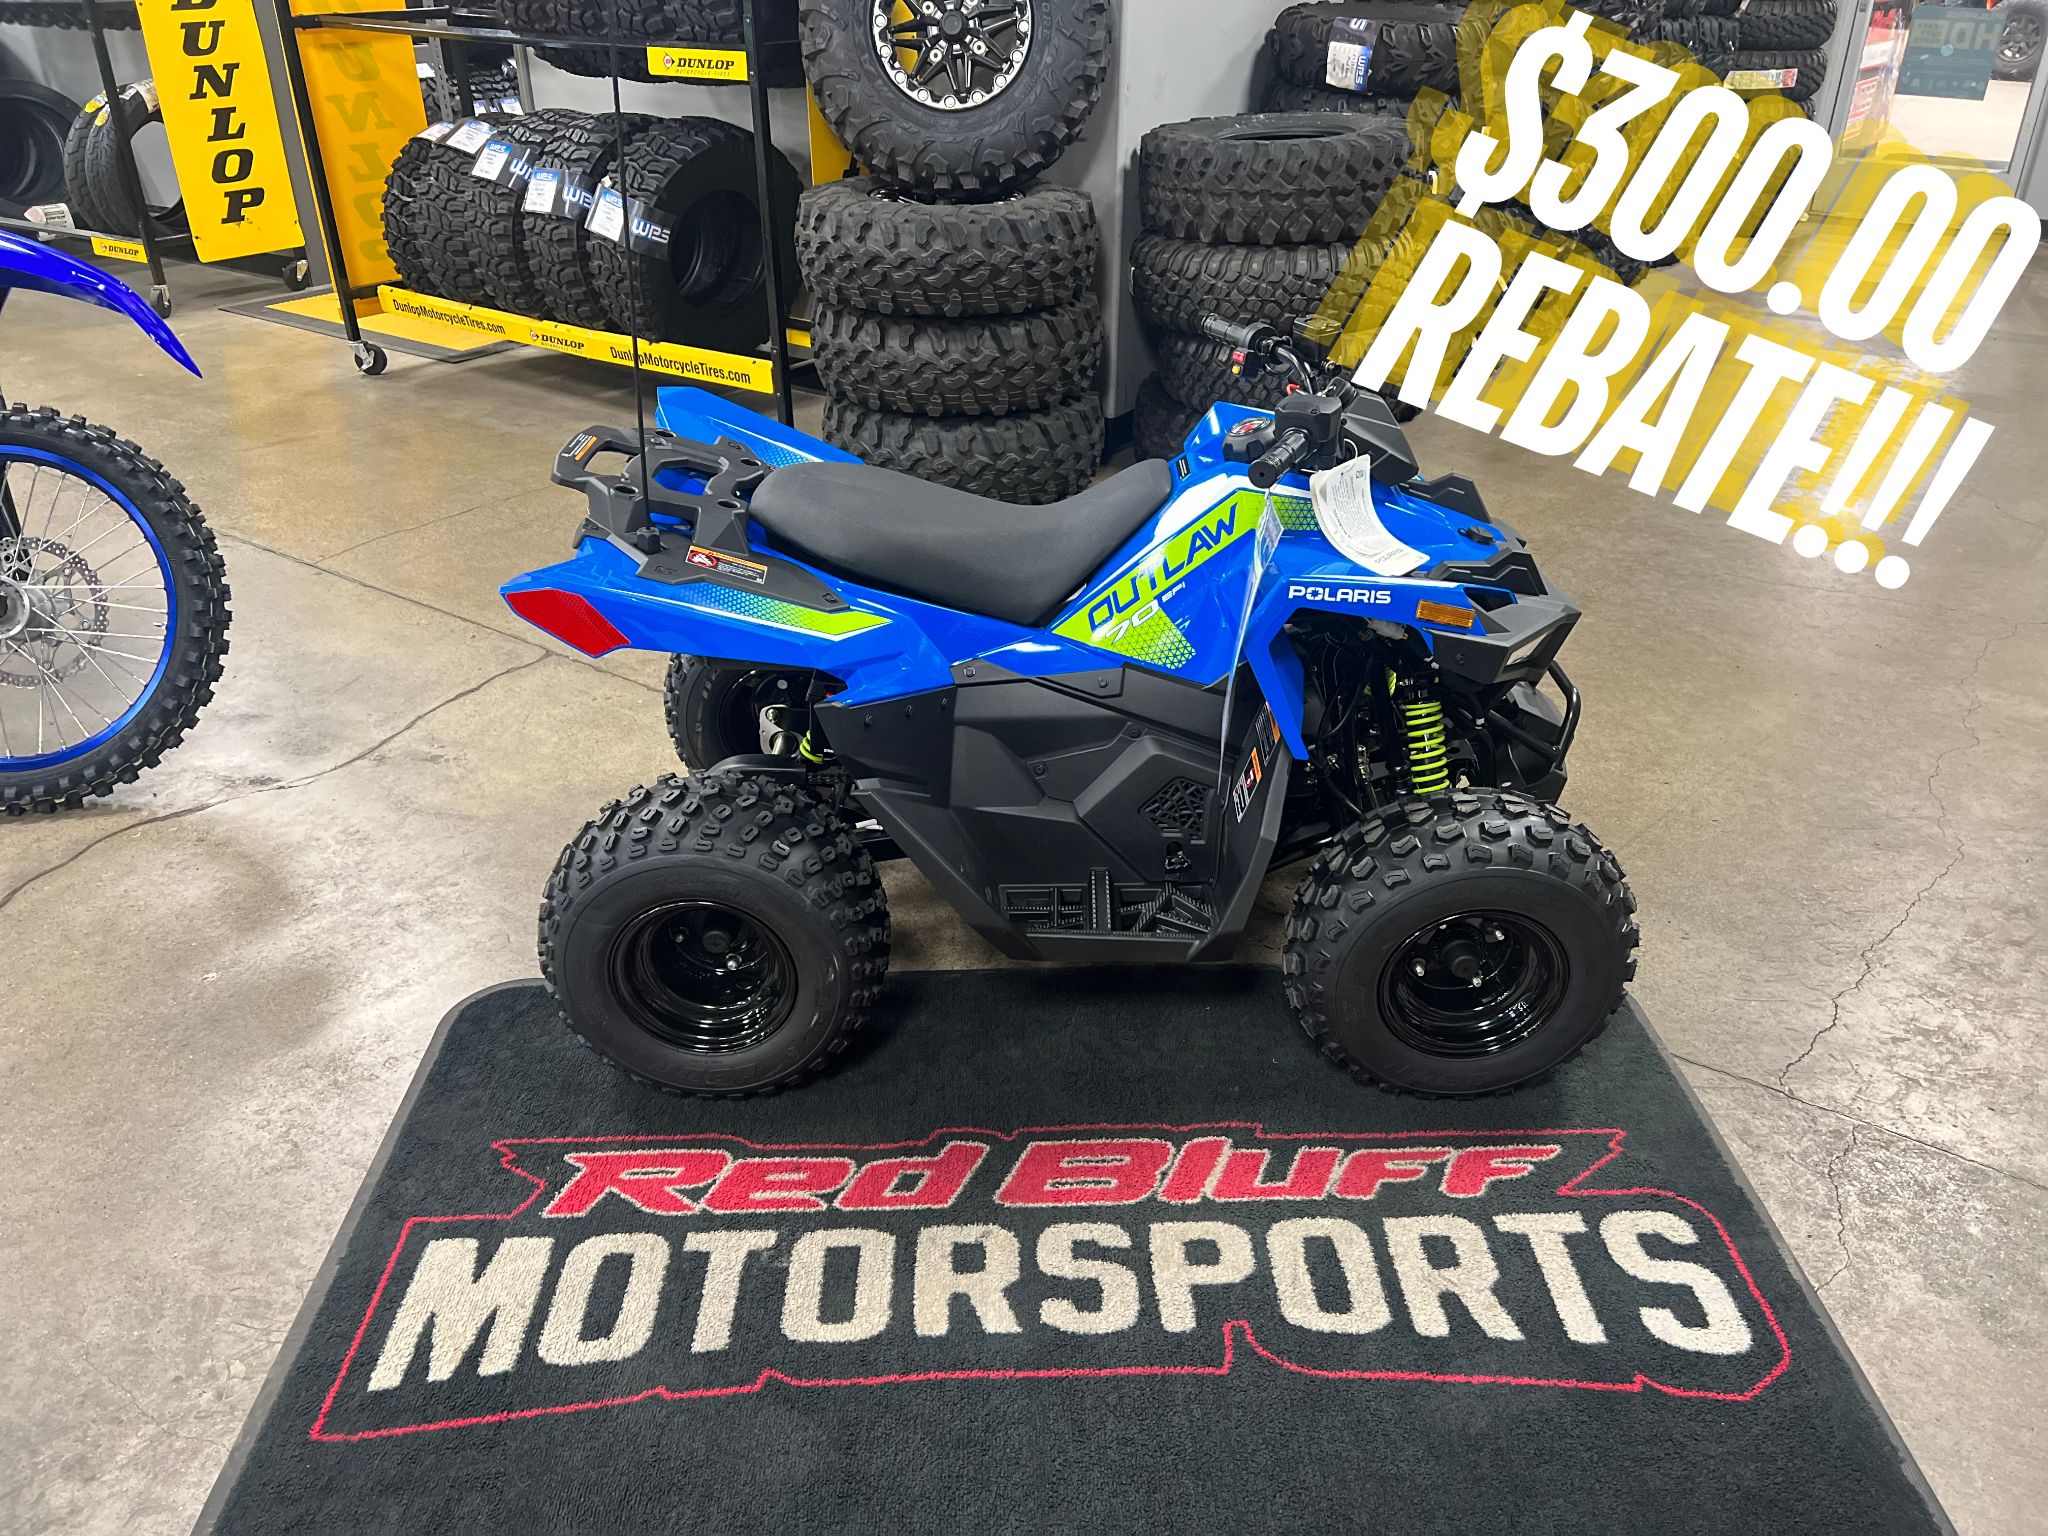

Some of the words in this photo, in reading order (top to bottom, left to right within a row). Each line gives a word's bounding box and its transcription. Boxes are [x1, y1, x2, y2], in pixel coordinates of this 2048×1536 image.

[676, 57, 735, 71] DUNLOP
[1355, 55, 1367, 85] WPS
[632, 216, 673, 245] WPS
[108, 245, 139, 257] DUNLOP
[392, 298, 507, 336] DunlopMotorcycleTires.com
[541, 333, 585, 350] DUNLOP
[609, 345, 752, 385] DunlpMotorcycleTires.com
[1087, 501, 1238, 633] OUTLAW
[1287, 585, 1392, 605] POLARIS
[1105, 599, 1161, 645] 70
[1161, 580, 1186, 603] EFI
[367, 1210, 1754, 1393] MOTORSPORTS
